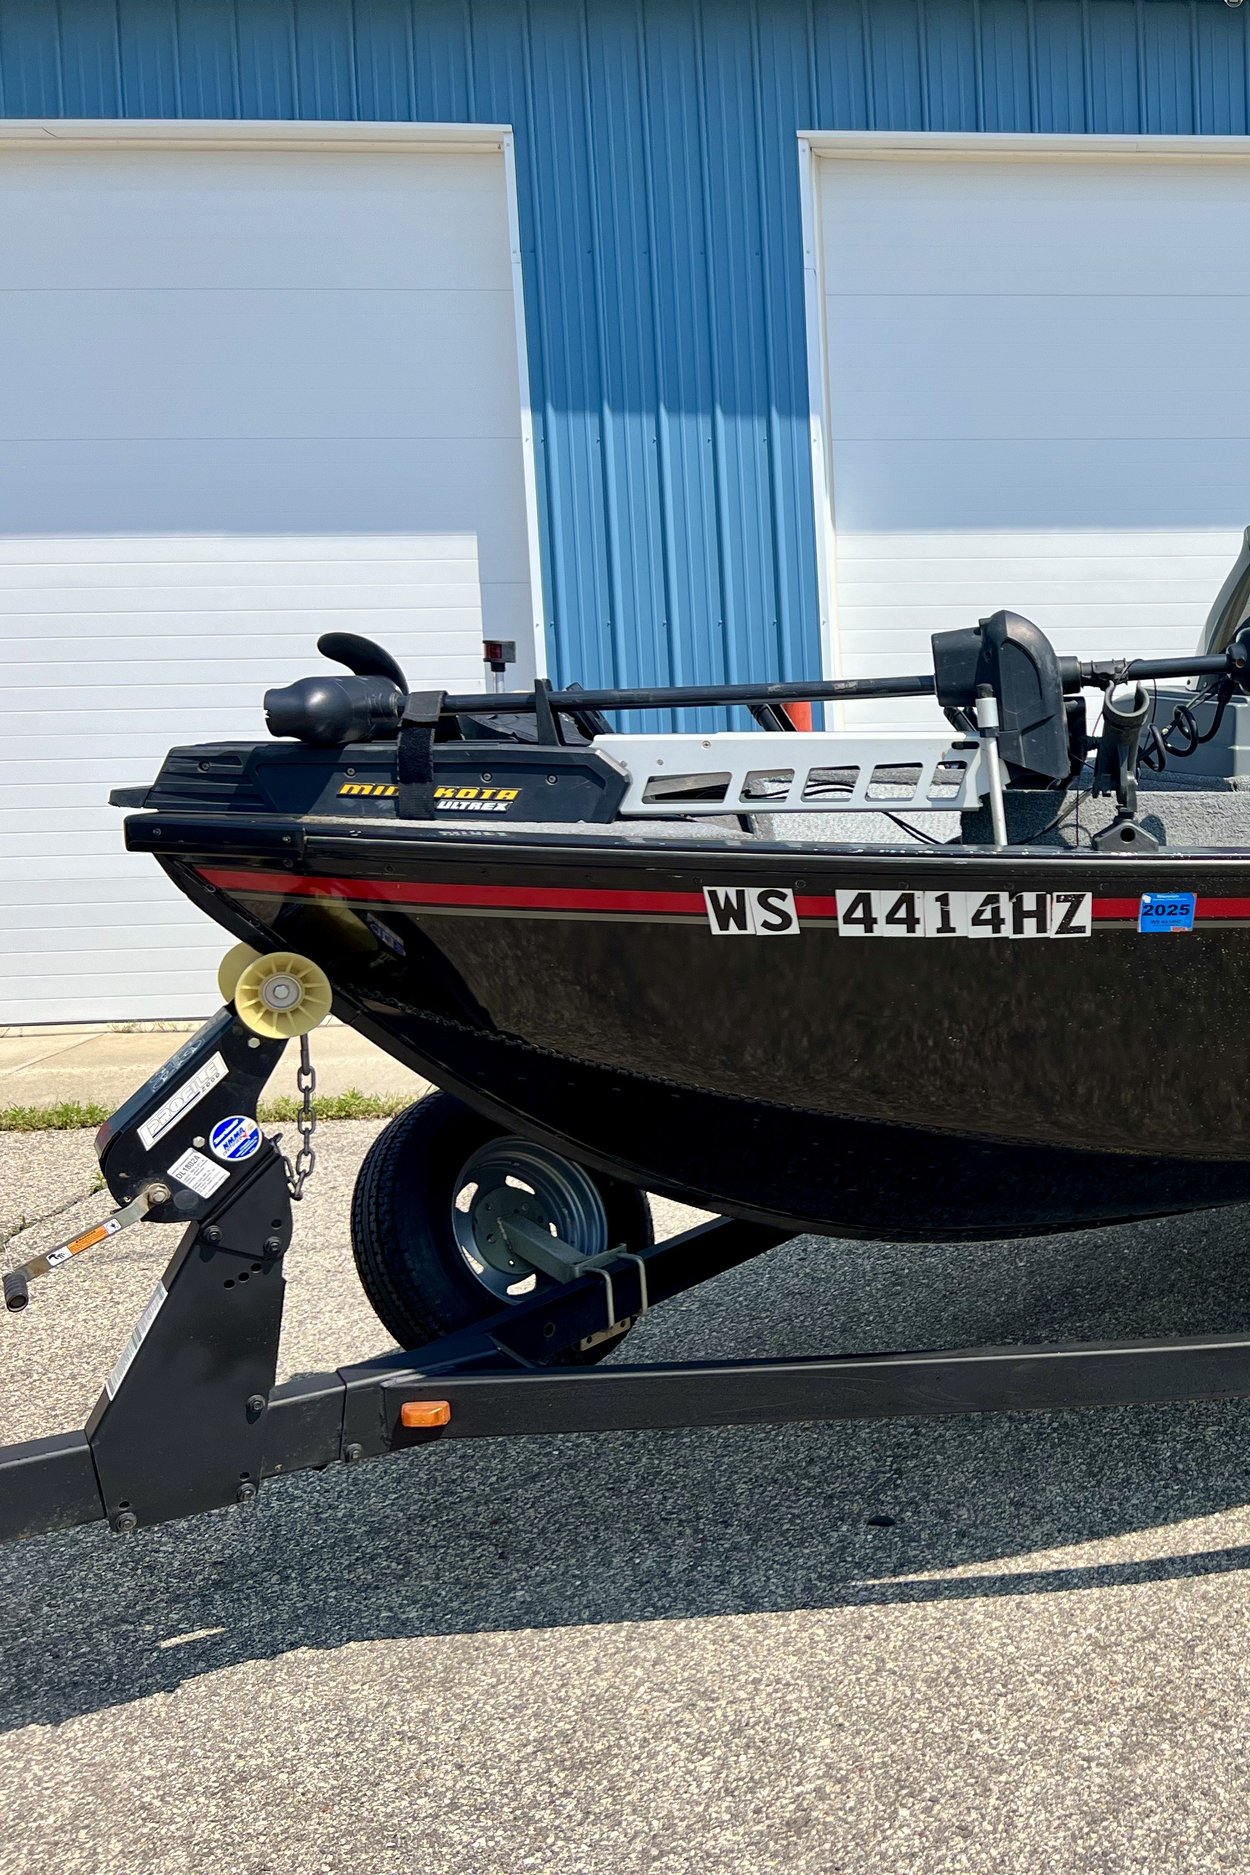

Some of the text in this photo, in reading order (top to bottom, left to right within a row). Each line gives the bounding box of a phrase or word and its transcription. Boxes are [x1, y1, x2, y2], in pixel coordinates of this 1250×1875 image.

[433, 786, 521, 800] KOTA
[436, 801, 510, 812] ULTREX
[706, 888, 1088, 935] WS 4414HZ
[1142, 904, 1190, 916] 2025
[146, 1061, 219, 1137] PROFILE
